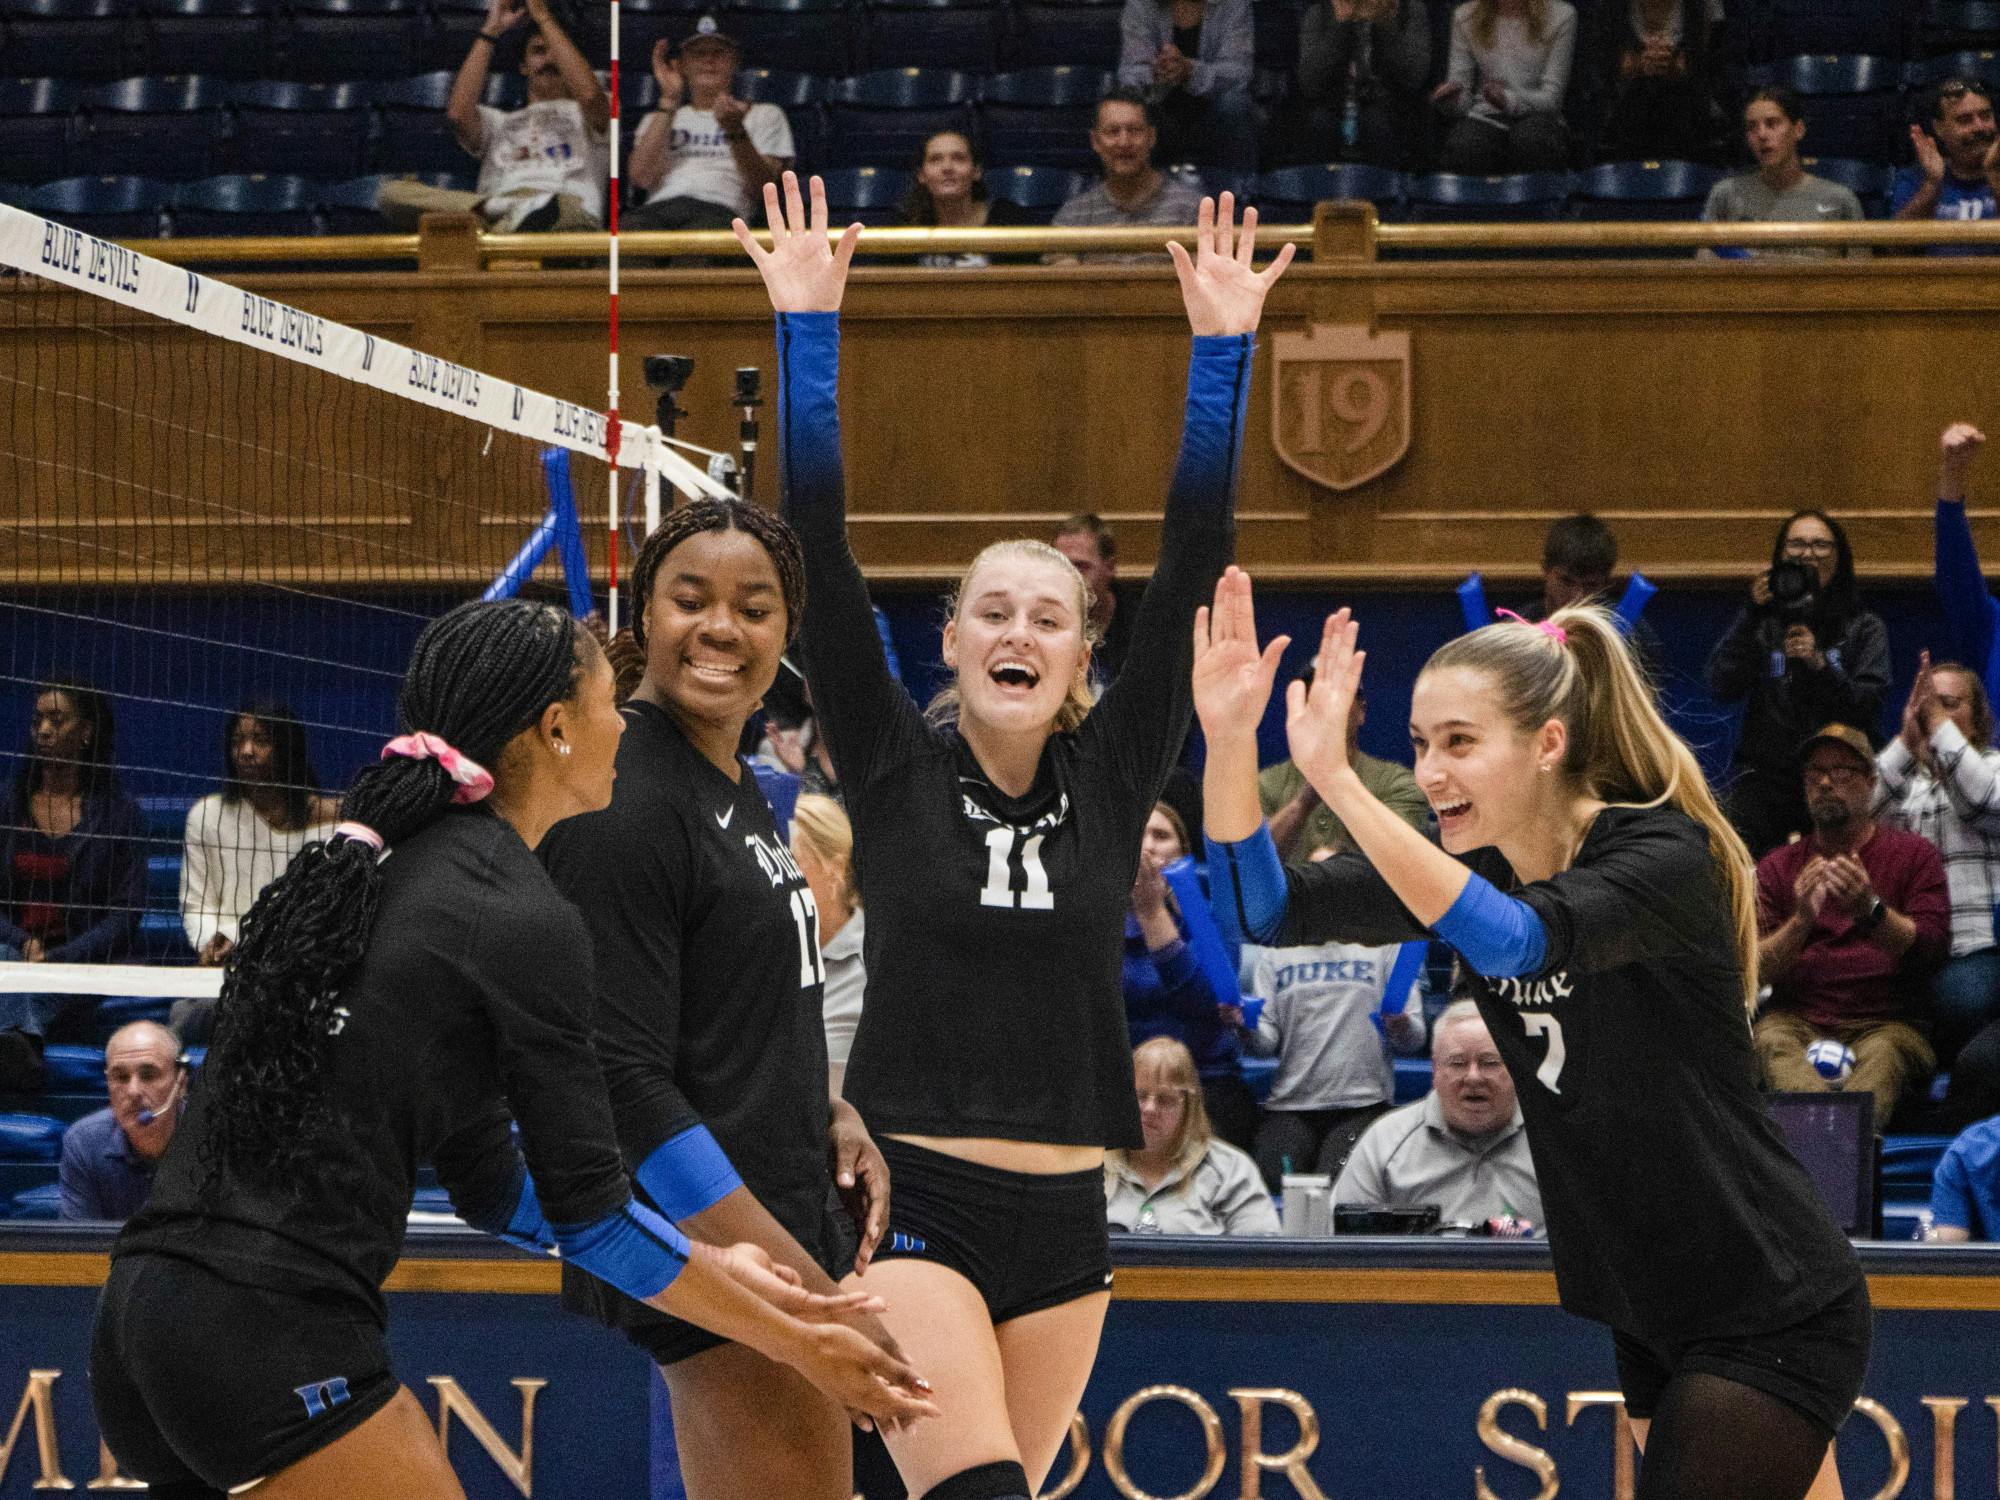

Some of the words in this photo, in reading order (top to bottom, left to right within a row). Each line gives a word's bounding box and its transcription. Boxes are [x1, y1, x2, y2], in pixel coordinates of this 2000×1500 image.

[42, 220, 83, 275] BLUE
[88, 237, 141, 294] DEVILS
[241, 292, 276, 341] BLUE
[280, 306, 324, 356] DEVILS
[408, 351, 439, 393] BLUE
[442, 362, 480, 408] DEVILS
[1294, 368, 1391, 454] 19
[980, 827, 1054, 910] 11
[1276, 960, 1375, 993] DUKE
[1518, 1012, 1566, 1095] 7
